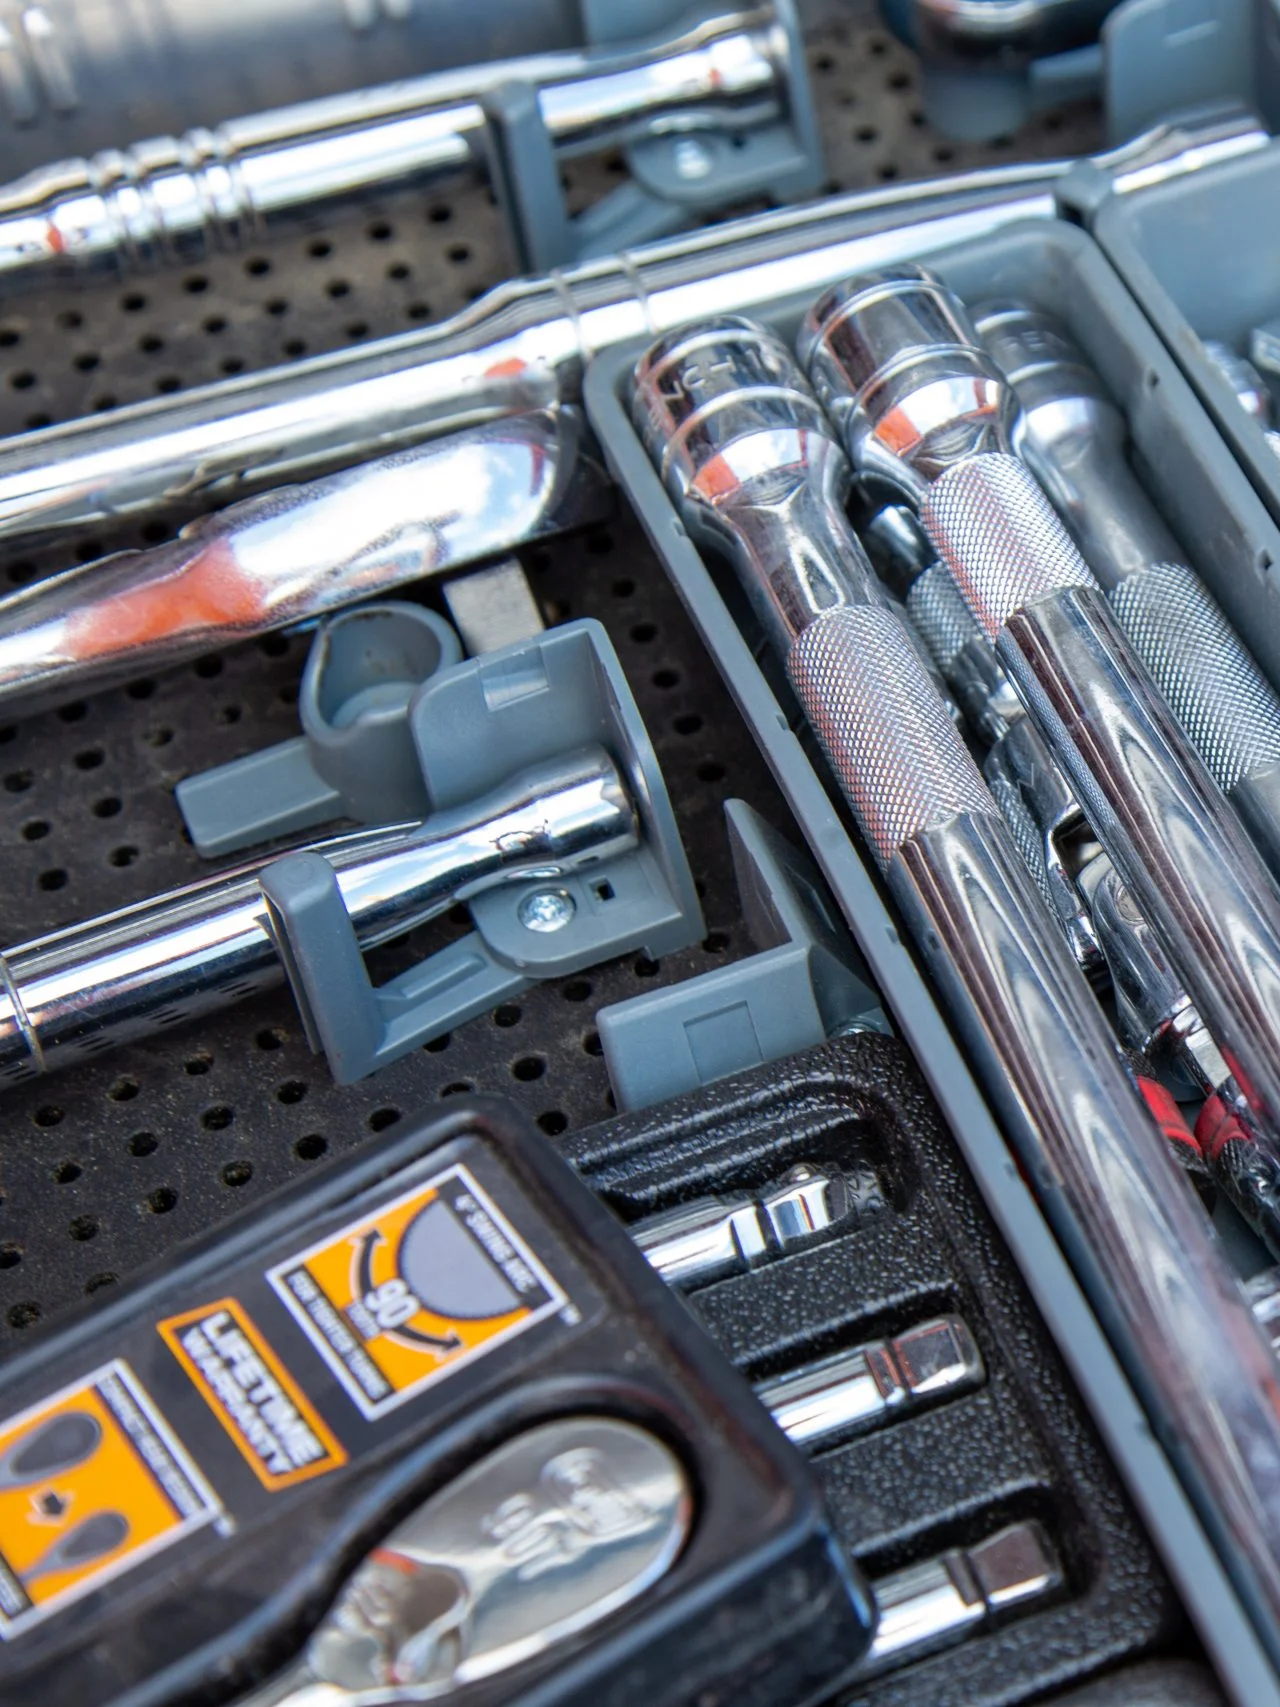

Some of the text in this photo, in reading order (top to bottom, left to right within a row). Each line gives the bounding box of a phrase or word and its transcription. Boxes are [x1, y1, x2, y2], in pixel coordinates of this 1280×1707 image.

[364, 1278, 420, 1328] 90
[182, 1326, 294, 1474] WARRANTY
[200, 1311, 325, 1467] LIFETIME
